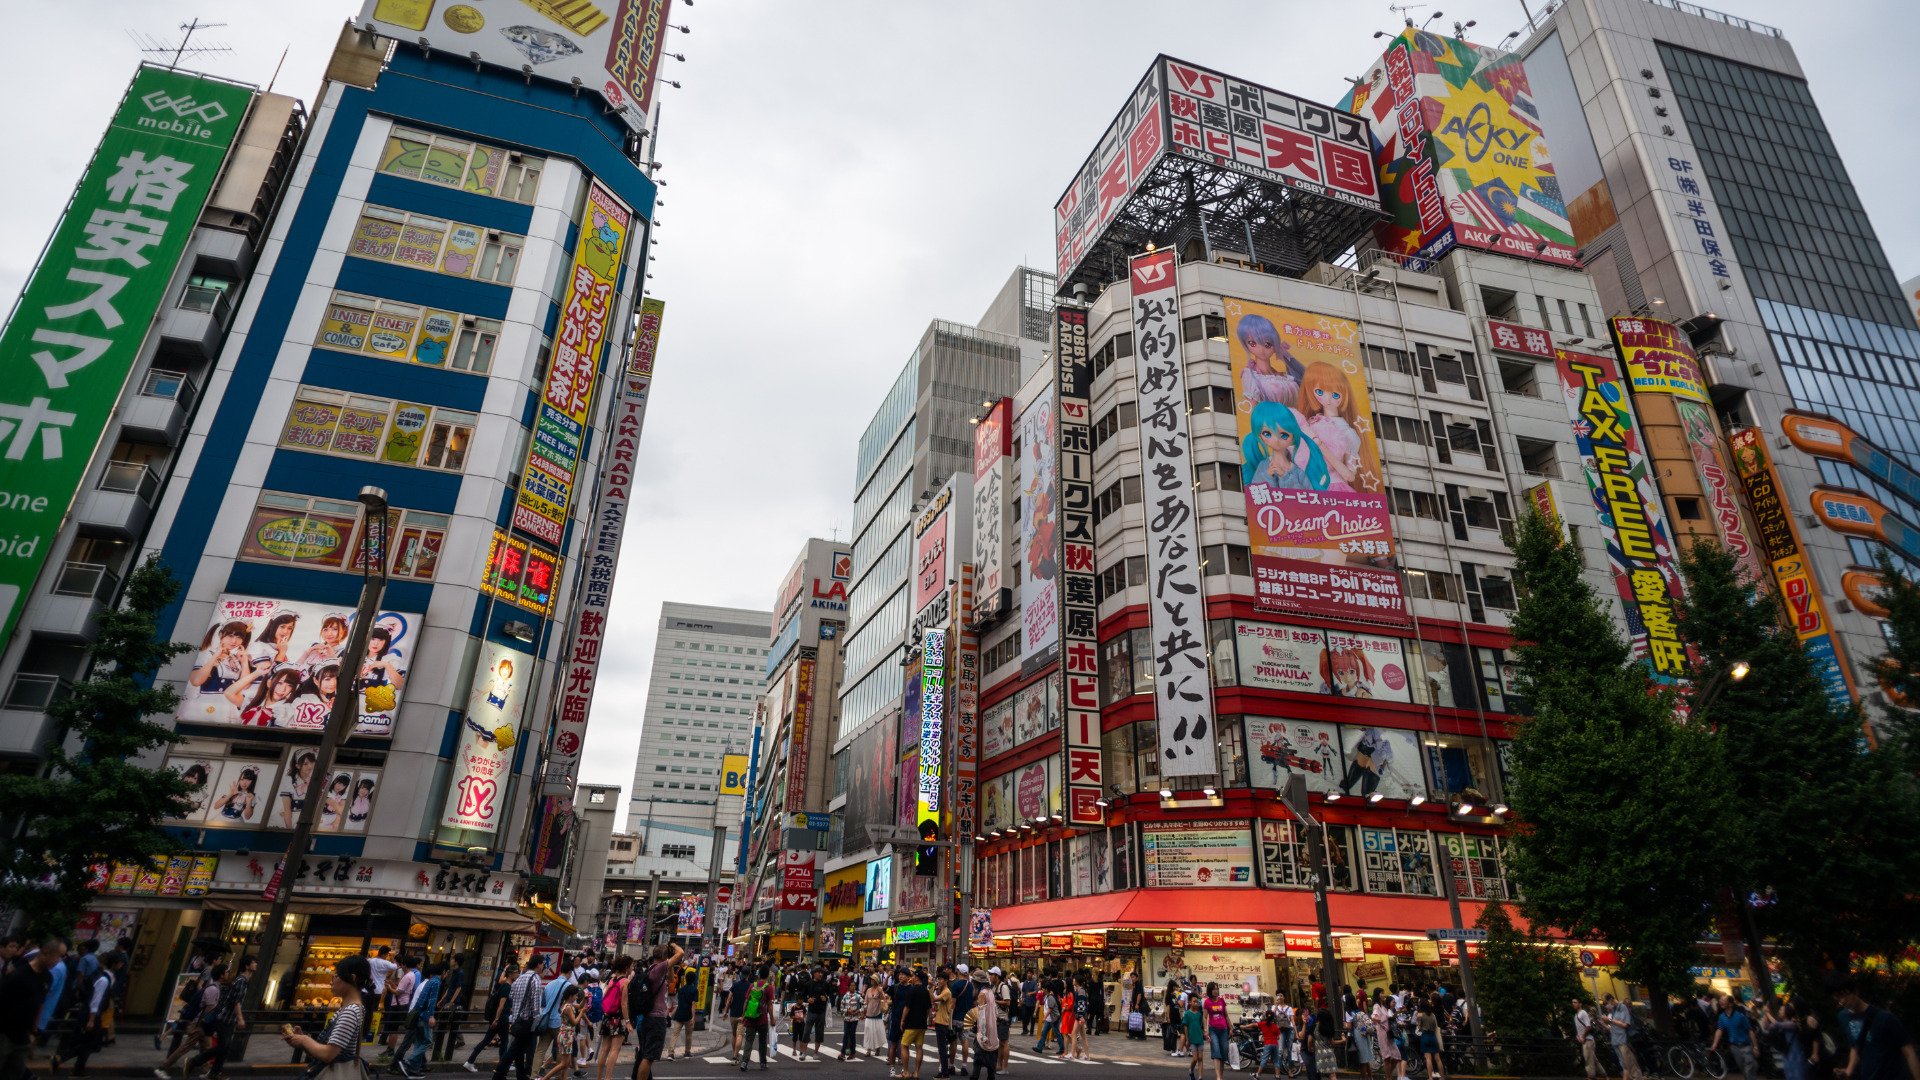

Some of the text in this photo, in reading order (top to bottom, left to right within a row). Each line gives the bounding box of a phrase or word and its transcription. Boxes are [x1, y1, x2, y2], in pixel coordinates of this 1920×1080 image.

[631, 63, 648, 102] TO
[137, 115, 212, 139] mobile
[1170, 91, 1260, 140] 秋葉原
[1228, 83, 1369, 148] ボークス
[1083, 69, 1159, 194] ボークス
[1397, 98, 1428, 165] DUTY
[1440, 105, 1531, 160] AKKY
[1098, 102, 1162, 226] 天国
[1172, 122, 1376, 197] ホビー 天国
[1492, 151, 1529, 170] ONE
[1667, 157, 1693, 174] 8F
[1173, 143, 1382, 212] VOLKS AKIHABARA HOBBY PARADISE
[1411, 157, 1444, 236] FREE
[1057, 187, 1097, 255] 秋葉原
[361, 222, 441, 247] インターネット
[1504, 238, 1536, 253] ONE
[354, 239, 436, 266] まんが喫茶
[0, 150, 195, 461] 格安スマホ
[330, 309, 414, 333] INTERNET
[339, 323, 352, 333] &
[425, 324, 451, 335] DRINK!
[429, 317, 451, 327] FREE
[1617, 320, 1646, 334] 激安
[323, 331, 363, 347] COMICS
[373, 339, 397, 350] cafe
[546, 264, 596, 407] まんが喫茶
[632, 313, 660, 373] まんが喫茶
[1071, 312, 1087, 368] HOBBY
[1495, 325, 1549, 354] 免税
[567, 282, 611, 418] インターネット
[1059, 310, 1075, 395] PARADISE
[1633, 377, 1695, 392] MEDIA WORLD
[295, 406, 384, 432] インターネット
[396, 418, 422, 429] 営業中!
[398, 411, 426, 421] 24時間
[545, 408, 578, 433] 完全分煙
[286, 425, 377, 452] まんが喫茶
[536, 431, 558, 447] FREE
[606, 402, 646, 500] TAKARADA
[1569, 361, 1658, 562] TAX FREE
[527, 467, 568, 495] コムコム
[530, 454, 572, 484] 24時間営業
[1746, 472, 1770, 488] ゲーム
[525, 478, 566, 508] 秋葉原店
[1250, 483, 1384, 509] 新サービス ドリームチョイス
[1752, 484, 1771, 499] CD
[1753, 496, 1778, 512] アイドル
[1757, 506, 1783, 524] アニメ
[1823, 499, 1875, 525] SEGA
[1256, 505, 1385, 540] Dream Choice
[1762, 519, 1786, 535] コミック
[264, 528, 336, 548] WELCOME
[1339, 539, 1391, 556] も大好評
[1768, 534, 1790, 547] ホビー
[1770, 544, 1795, 560] フィギュア
[493, 545, 552, 590] 麻雀
[584, 553, 615, 608] 免税商店
[1257, 567, 1400, 596] ラジオ会館8F Doll Point
[224, 600, 275, 610] ありがとう
[1258, 582, 1402, 610] 増床リニューアル営業中!!
[1785, 577, 1821, 635] DVD
[229, 609, 265, 618] 10周年
[911, 590, 949, 642] ESPACE
[1237, 624, 1320, 645] ボークス初! 女の子
[1329, 636, 1399, 654] プラキット登場!!
[561, 609, 604, 724] 歓迎光臨
[960, 654, 977, 692] 買取り
[1252, 676, 1276, 685] ブロッカーズ
[469, 755, 502, 769] ありがとう
[471, 764, 494, 777] 10周年
[958, 779, 974, 845] アキバ駅前
[459, 819, 495, 830] ANNIVERSARY
[1263, 822, 1289, 842] 4F
[1363, 831, 1395, 850] 5F
[112, 873, 186, 887] まんが
[355, 874, 373, 883] 時間
[357, 866, 375, 876] 24
[787, 867, 811, 877] アコム
[493, 880, 505, 889] 24
[1223, 935, 1253, 945] ホビー天国
[1215, 973, 1232, 981] 2017
